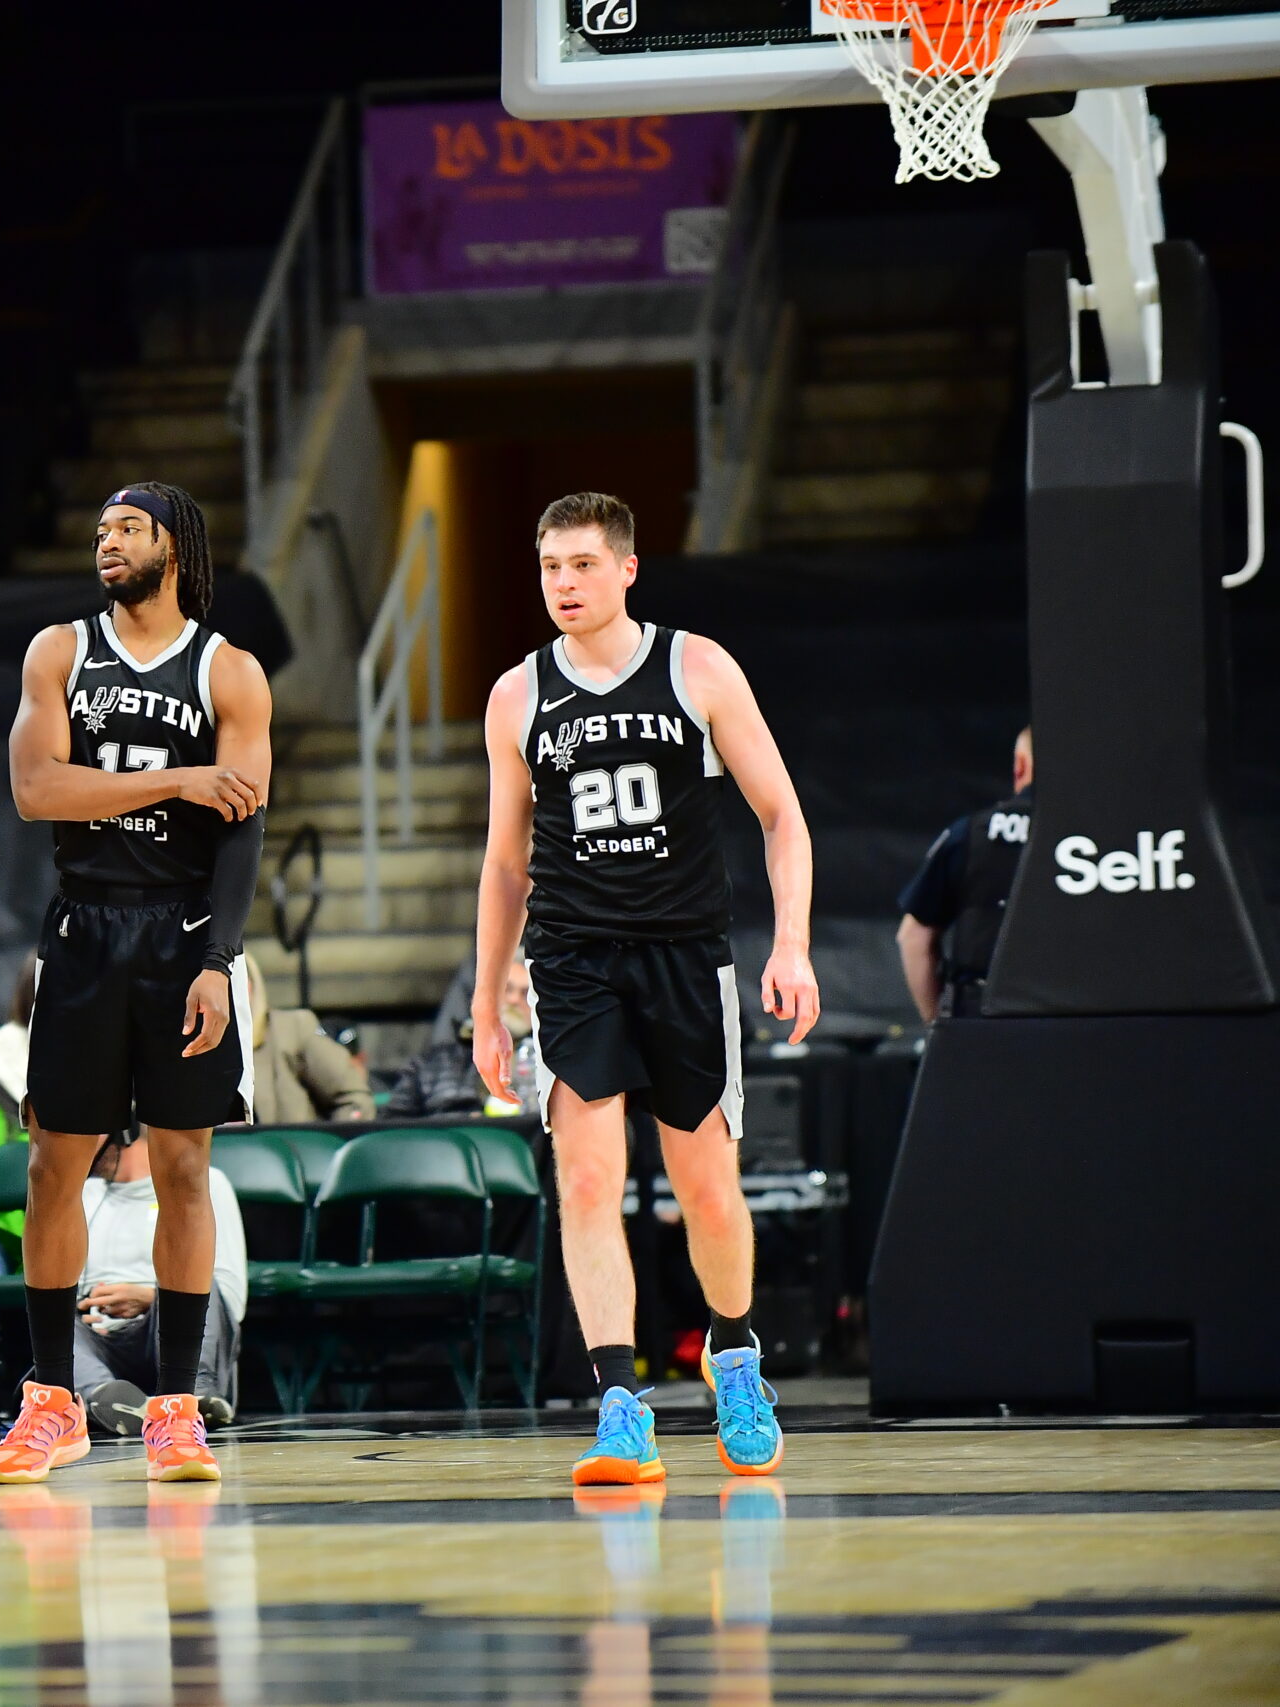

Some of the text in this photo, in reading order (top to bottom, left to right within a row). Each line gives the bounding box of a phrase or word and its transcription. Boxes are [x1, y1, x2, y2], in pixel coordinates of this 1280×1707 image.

[70, 686, 203, 738] AUSTIN
[537, 713, 684, 772] AUSTIN
[569, 762, 663, 832] 20
[586, 835, 656, 853] LEDGER
[1054, 829, 1196, 895] Self.
